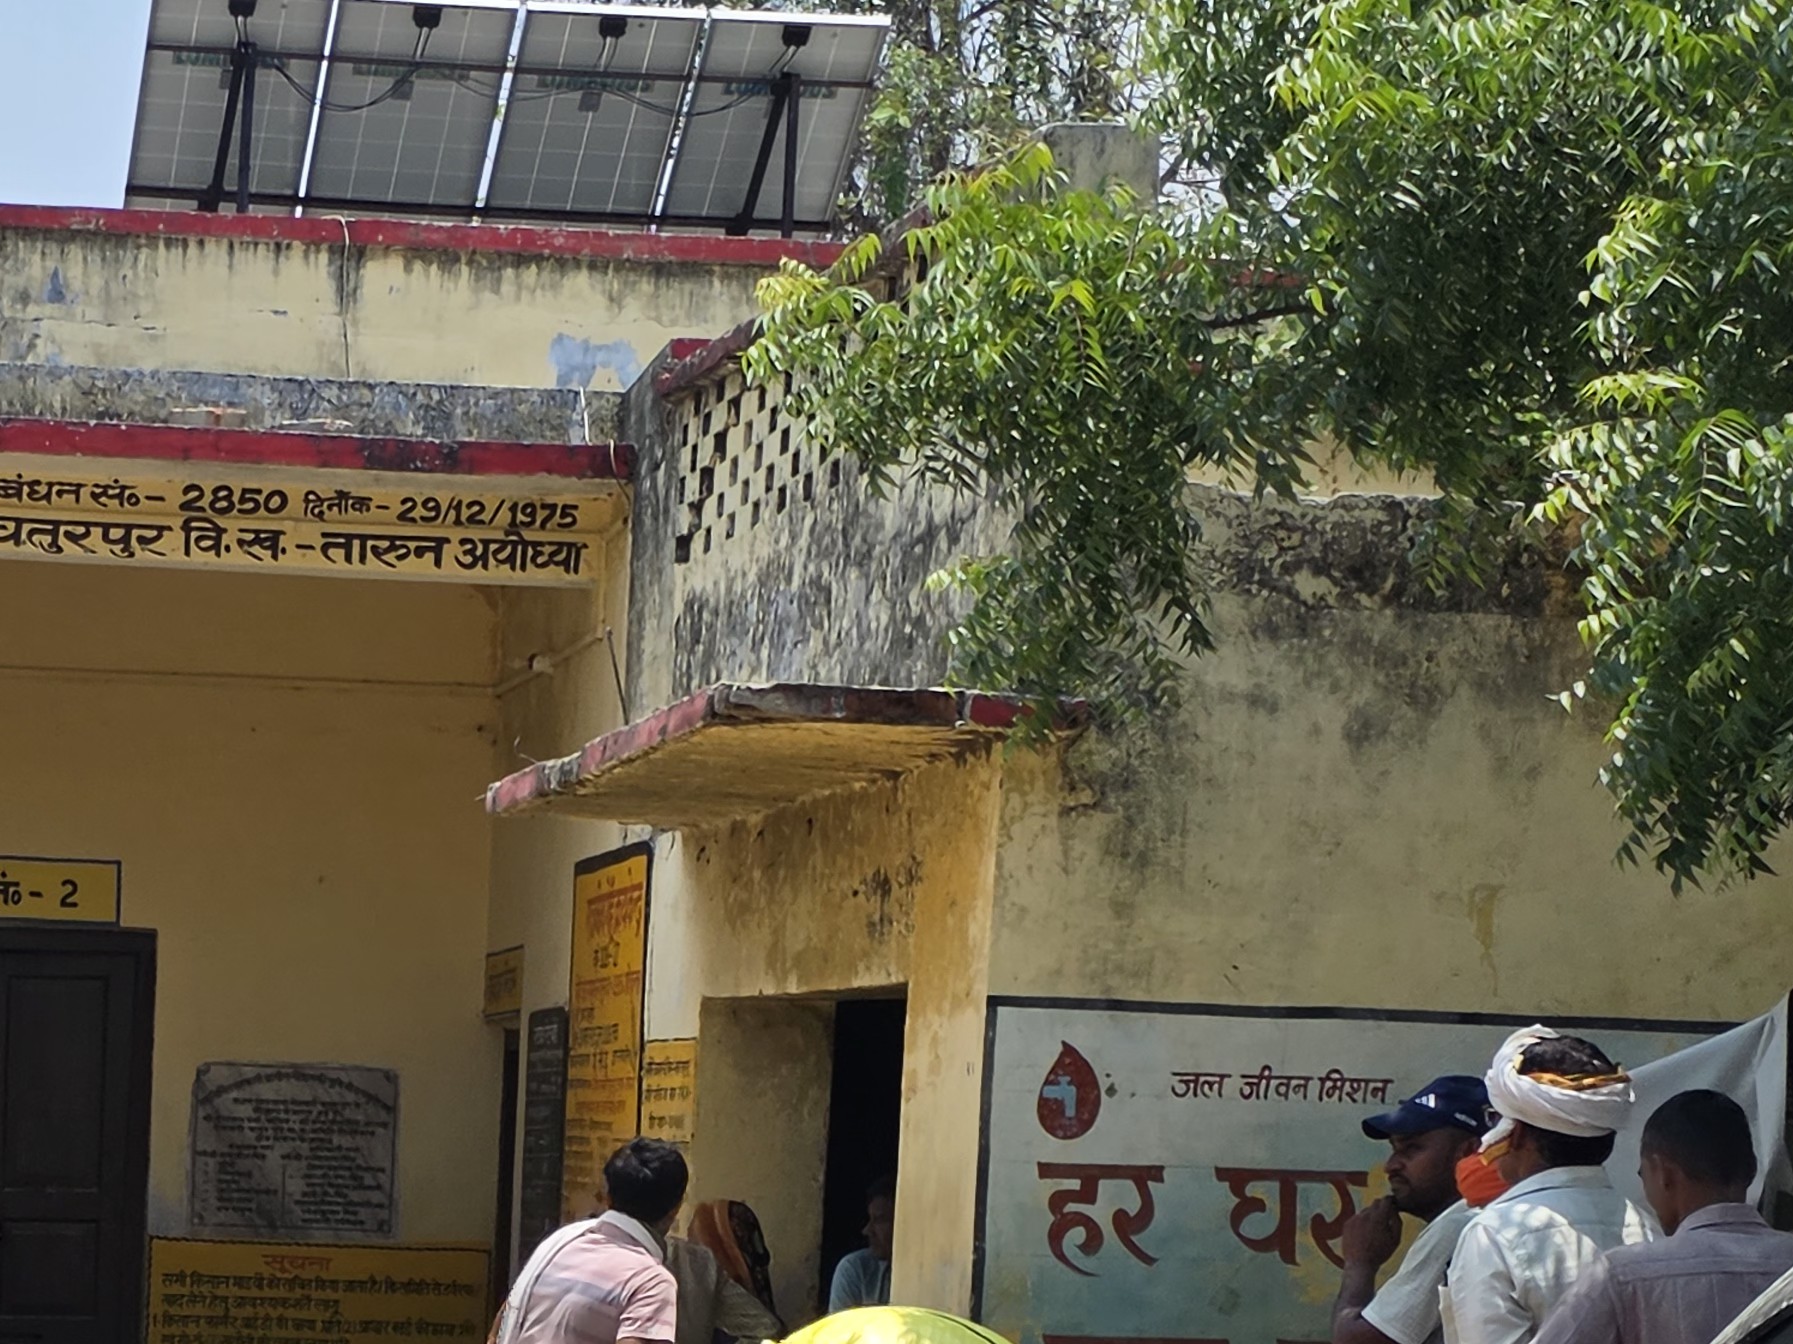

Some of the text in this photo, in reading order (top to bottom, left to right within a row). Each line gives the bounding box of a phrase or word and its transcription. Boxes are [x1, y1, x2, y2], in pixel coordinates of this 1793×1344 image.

[177, 484, 289, 516] 2850
[395, 495, 579, 531] 29/12/1975
[454, 527, 589, 576] अयोध्या
[60, 879, 79, 909] 2
[1170, 1064, 1395, 1105] जल जीवन मिशन
[1037, 1161, 1369, 1277] हर घर
[263, 1253, 334, 1276] सूचना
